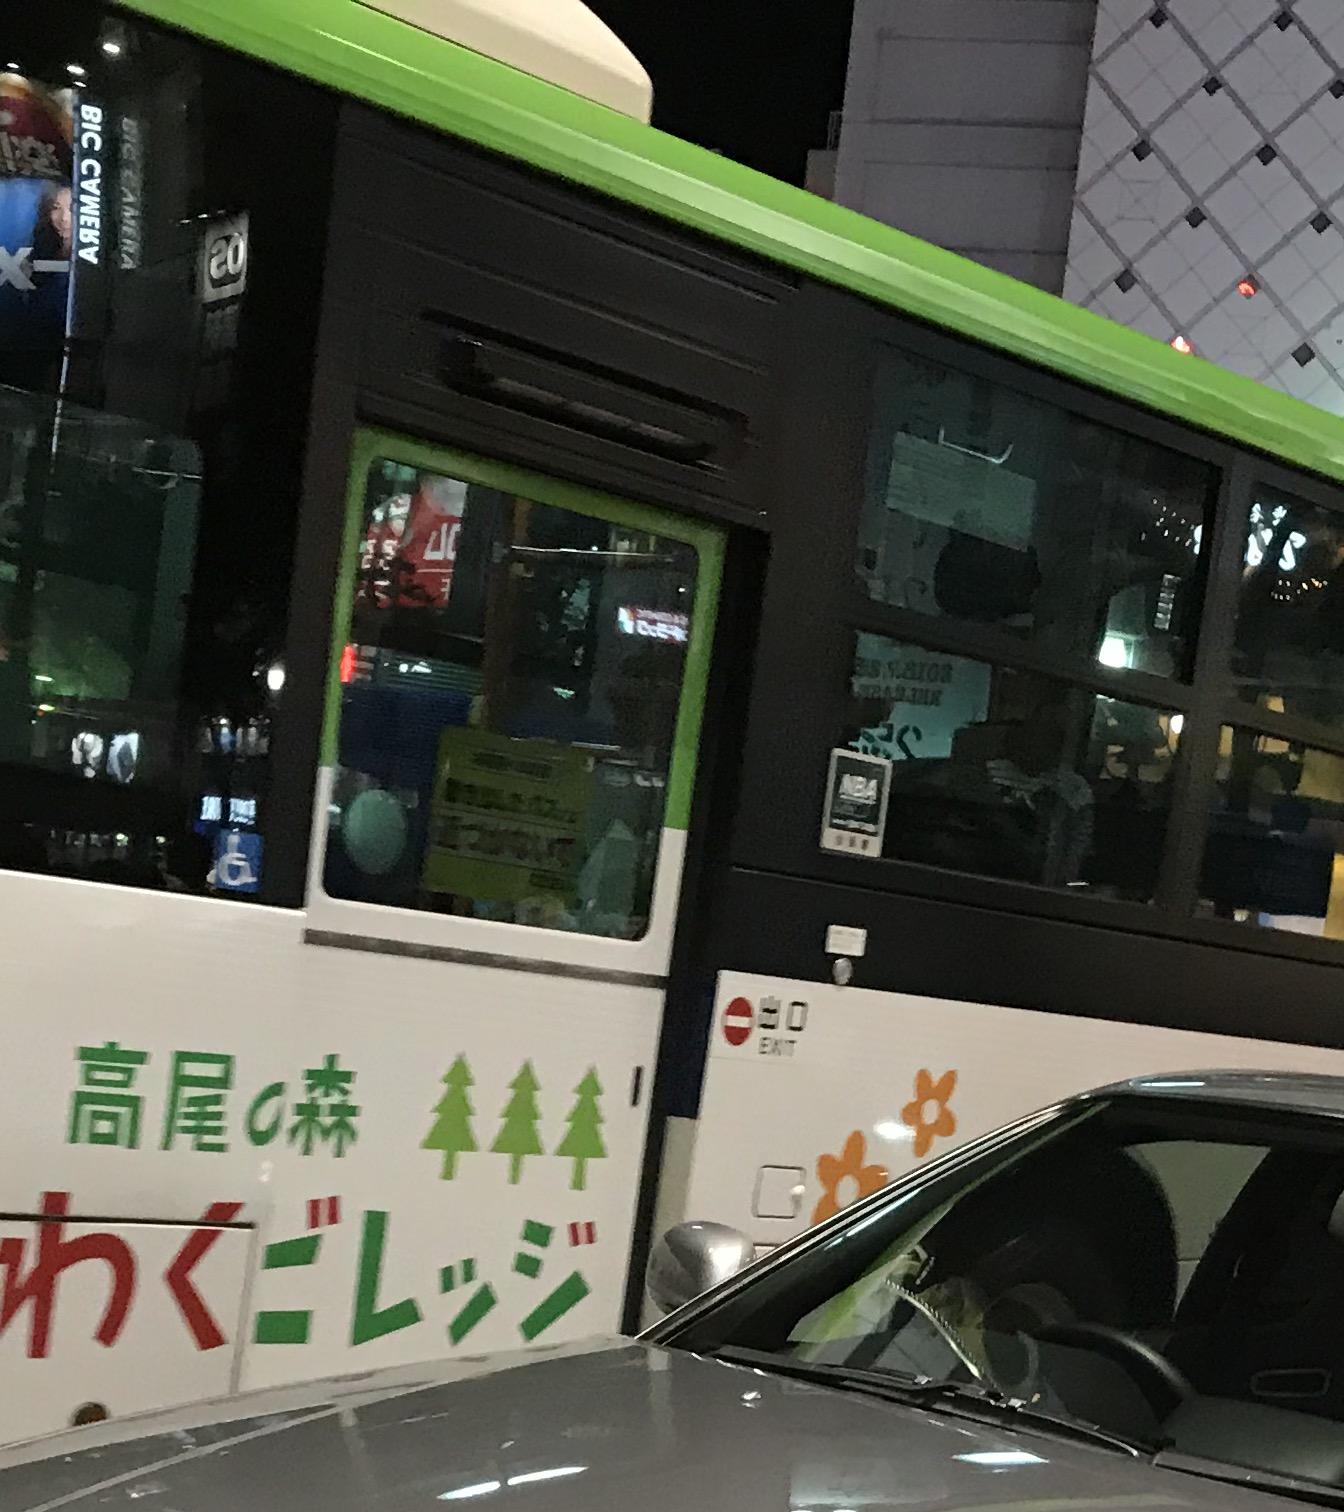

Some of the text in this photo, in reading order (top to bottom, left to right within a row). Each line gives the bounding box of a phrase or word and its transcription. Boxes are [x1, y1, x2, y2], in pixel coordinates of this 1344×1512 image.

[758, 995, 808, 1032] 出口
[758, 1037, 797, 1057] EXIT
[67, 1041, 361, 1157] 高尾の森
